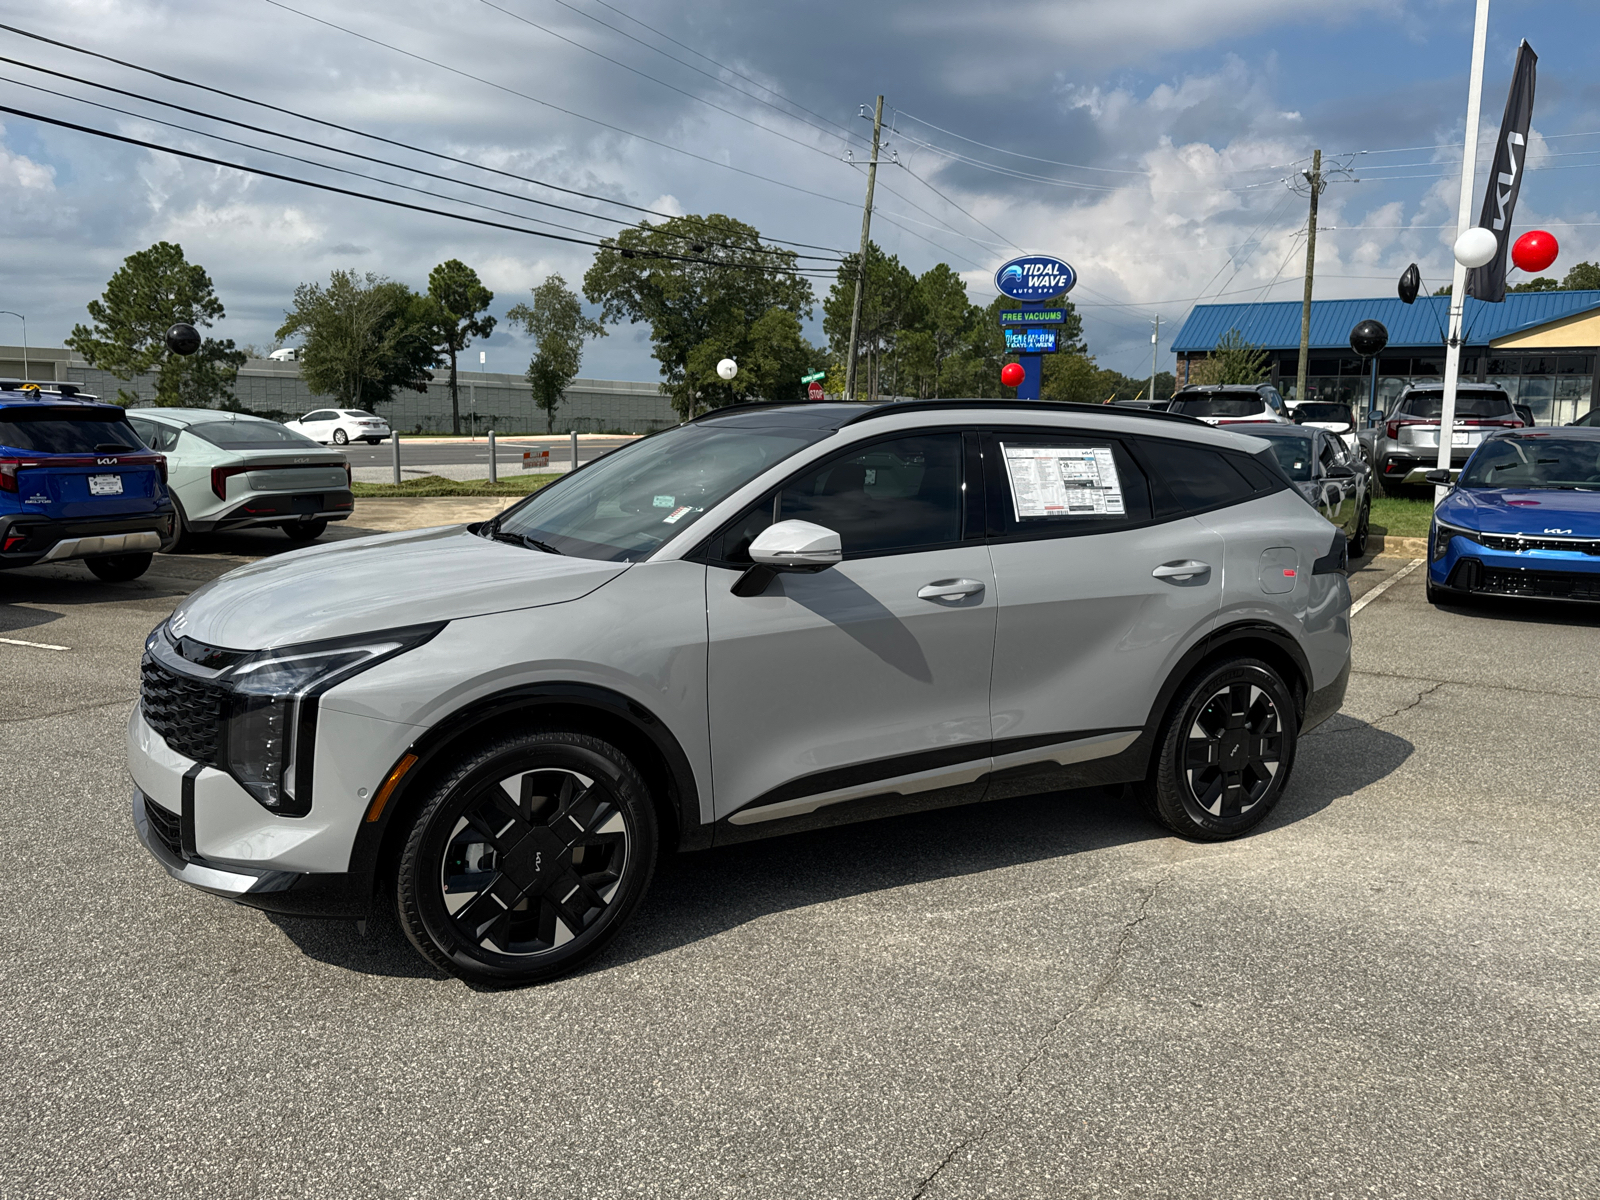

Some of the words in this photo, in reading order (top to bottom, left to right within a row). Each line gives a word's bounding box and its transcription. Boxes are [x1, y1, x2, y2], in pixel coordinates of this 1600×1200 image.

[1493, 130, 1525, 231] KIA
[1023, 263, 1060, 276] TIDAL
[1028, 275, 1068, 287] WAVE
[1002, 312, 1023, 321] FREE
[1024, 311, 1062, 320] VACUUMS
[809, 389, 823, 399] STOP
